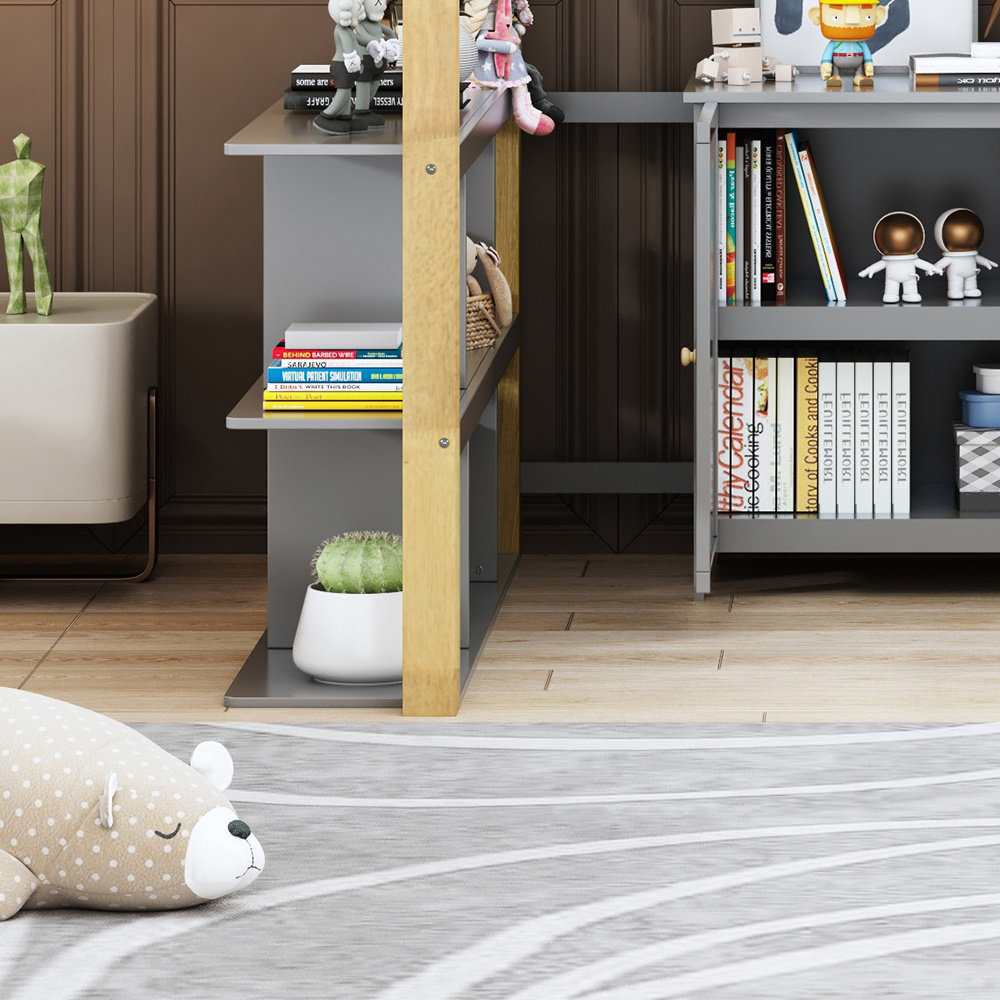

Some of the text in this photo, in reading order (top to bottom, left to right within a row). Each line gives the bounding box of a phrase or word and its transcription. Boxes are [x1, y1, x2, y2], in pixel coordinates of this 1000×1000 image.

[306, 97, 330, 106] GRAFF
[373, 97, 396, 106] VESSEL
[282, 371, 306, 382] VIRTUAL
[306, 371, 329, 382] PATIENT
[329, 371, 362, 382] SIMULATION
[718, 359, 744, 469] Calendar
[804, 398, 818, 421] and
[804, 424, 818, 464] Cooks
[744, 422, 763, 511] ic Cooking
[804, 468, 818, 480] of
